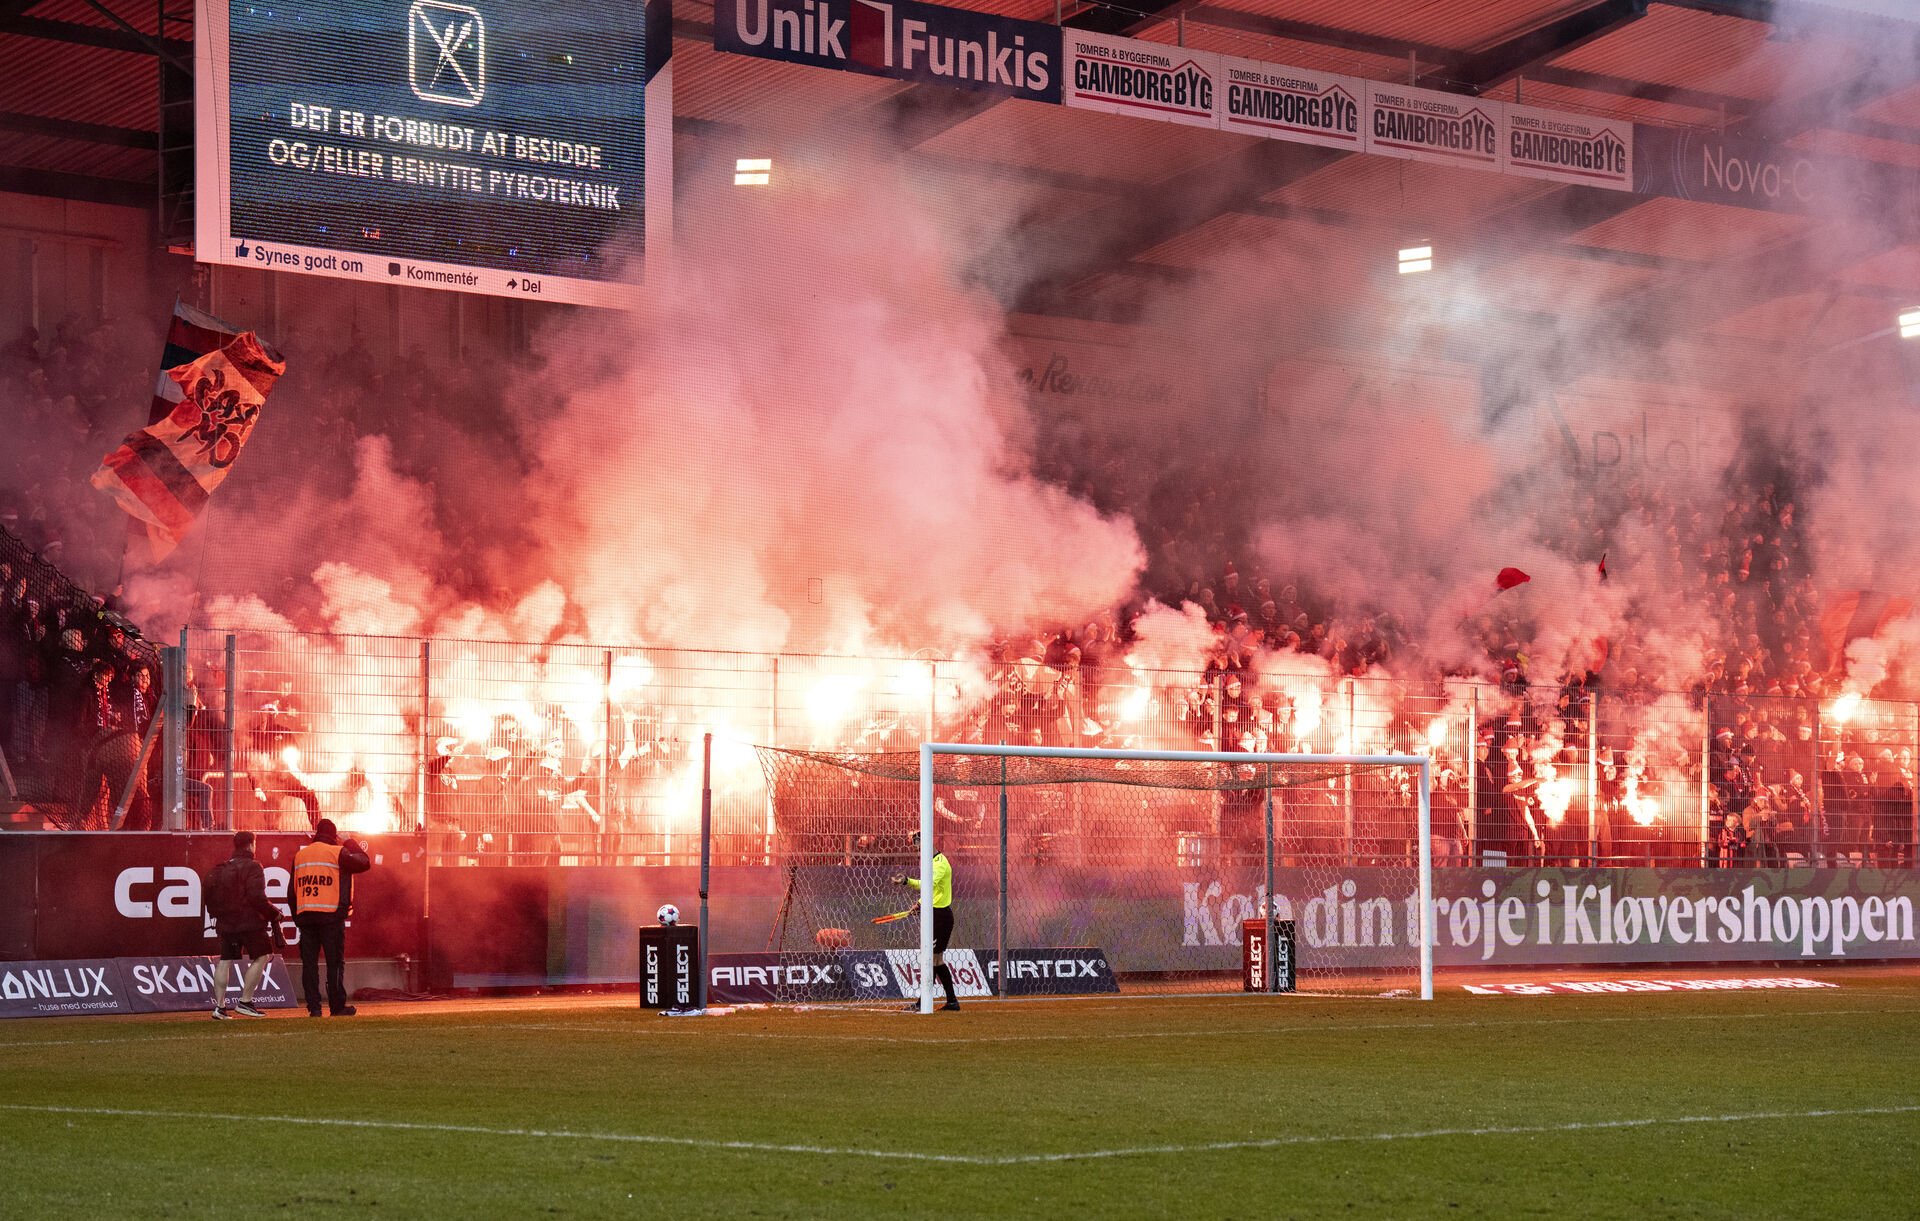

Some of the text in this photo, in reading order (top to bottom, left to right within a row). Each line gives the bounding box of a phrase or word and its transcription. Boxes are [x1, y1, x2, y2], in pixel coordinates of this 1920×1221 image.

[735, 0, 1050, 91] Unik Funkis
[1075, 42, 1171, 68] TØMRER & BYGGEFIRMA
[1229, 69, 1319, 92] TØMRER & BYGGEFIRMA
[290, 102, 601, 170] DET ER FORBUDT AT BESIDDE
[268, 138, 620, 210] OG/ELLER BENYTTE PYROTEKNIK
[255, 245, 364, 273] Synes godt om
[406, 265, 479, 287] Kommentér
[521, 279, 542, 293] Del
[1303, 879, 1395, 948] din
[1406, 880, 1526, 960] trøje
[1536, 879, 1553, 945] i
[1562, 883, 1915, 956] Kløvershoppen
[647, 944, 659, 1004] SELECT
[676, 944, 690, 1004] SELECT
[855, 963, 889, 987] SB
[1250, 935, 1262, 988] SELECT
[1278, 935, 1289, 988] SELECT
[38, 1003, 59, 1011] huse
[61, 1001, 80, 1010] med
[82, 1000, 118, 1010] overskud
[252, 994, 286, 1003] overskud
